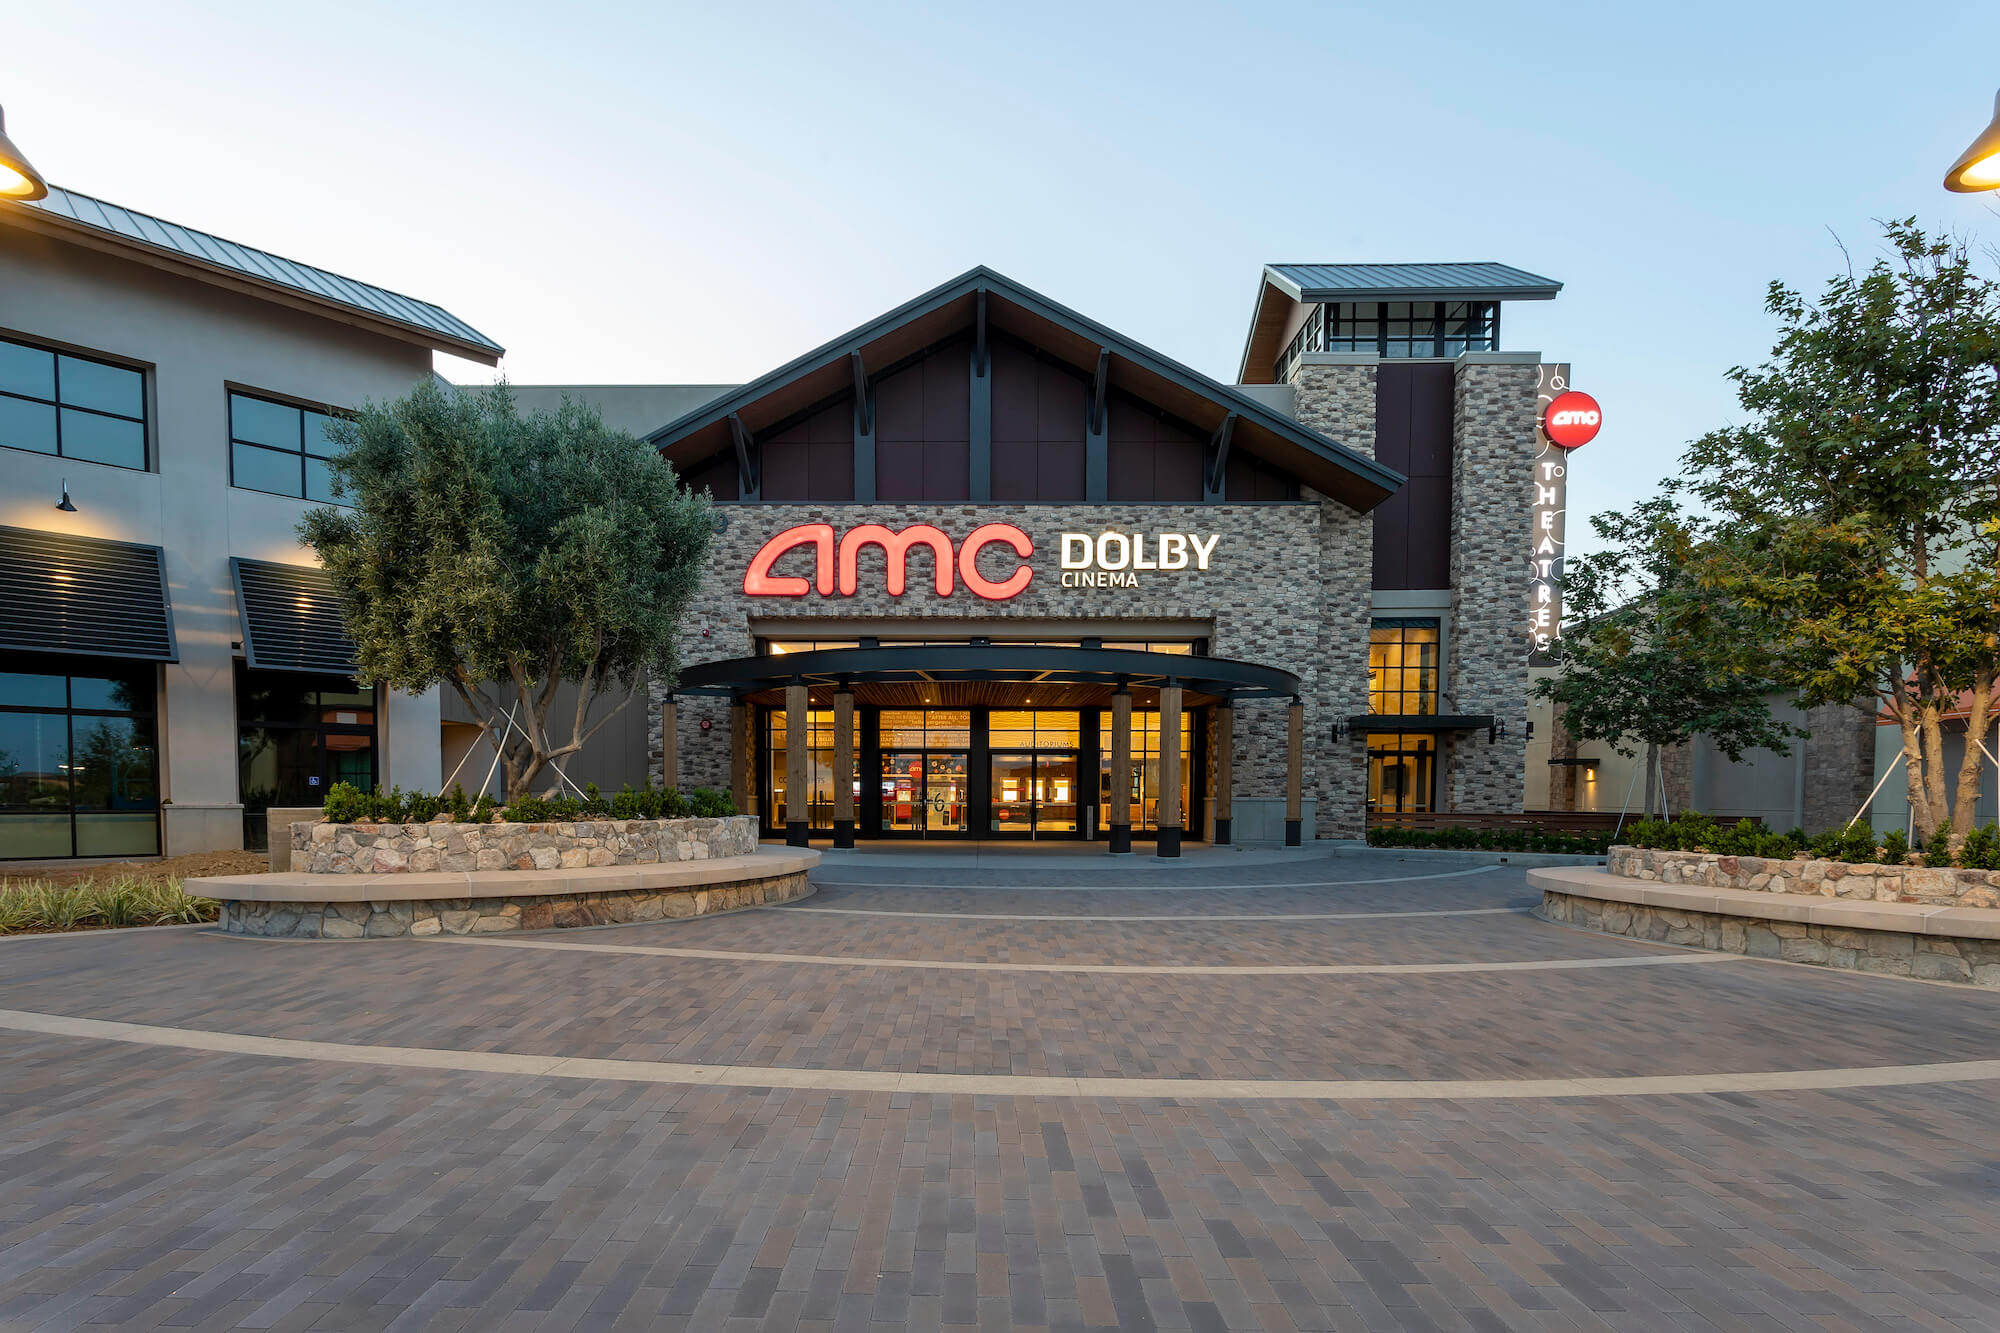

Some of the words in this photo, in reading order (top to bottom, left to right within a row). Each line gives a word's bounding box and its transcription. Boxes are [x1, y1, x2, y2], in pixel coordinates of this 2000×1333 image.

[1060, 532, 1221, 571] DOLBY
[1537, 462, 1556, 652] THEATRES
[1061, 572, 1139, 588] CINEMA
